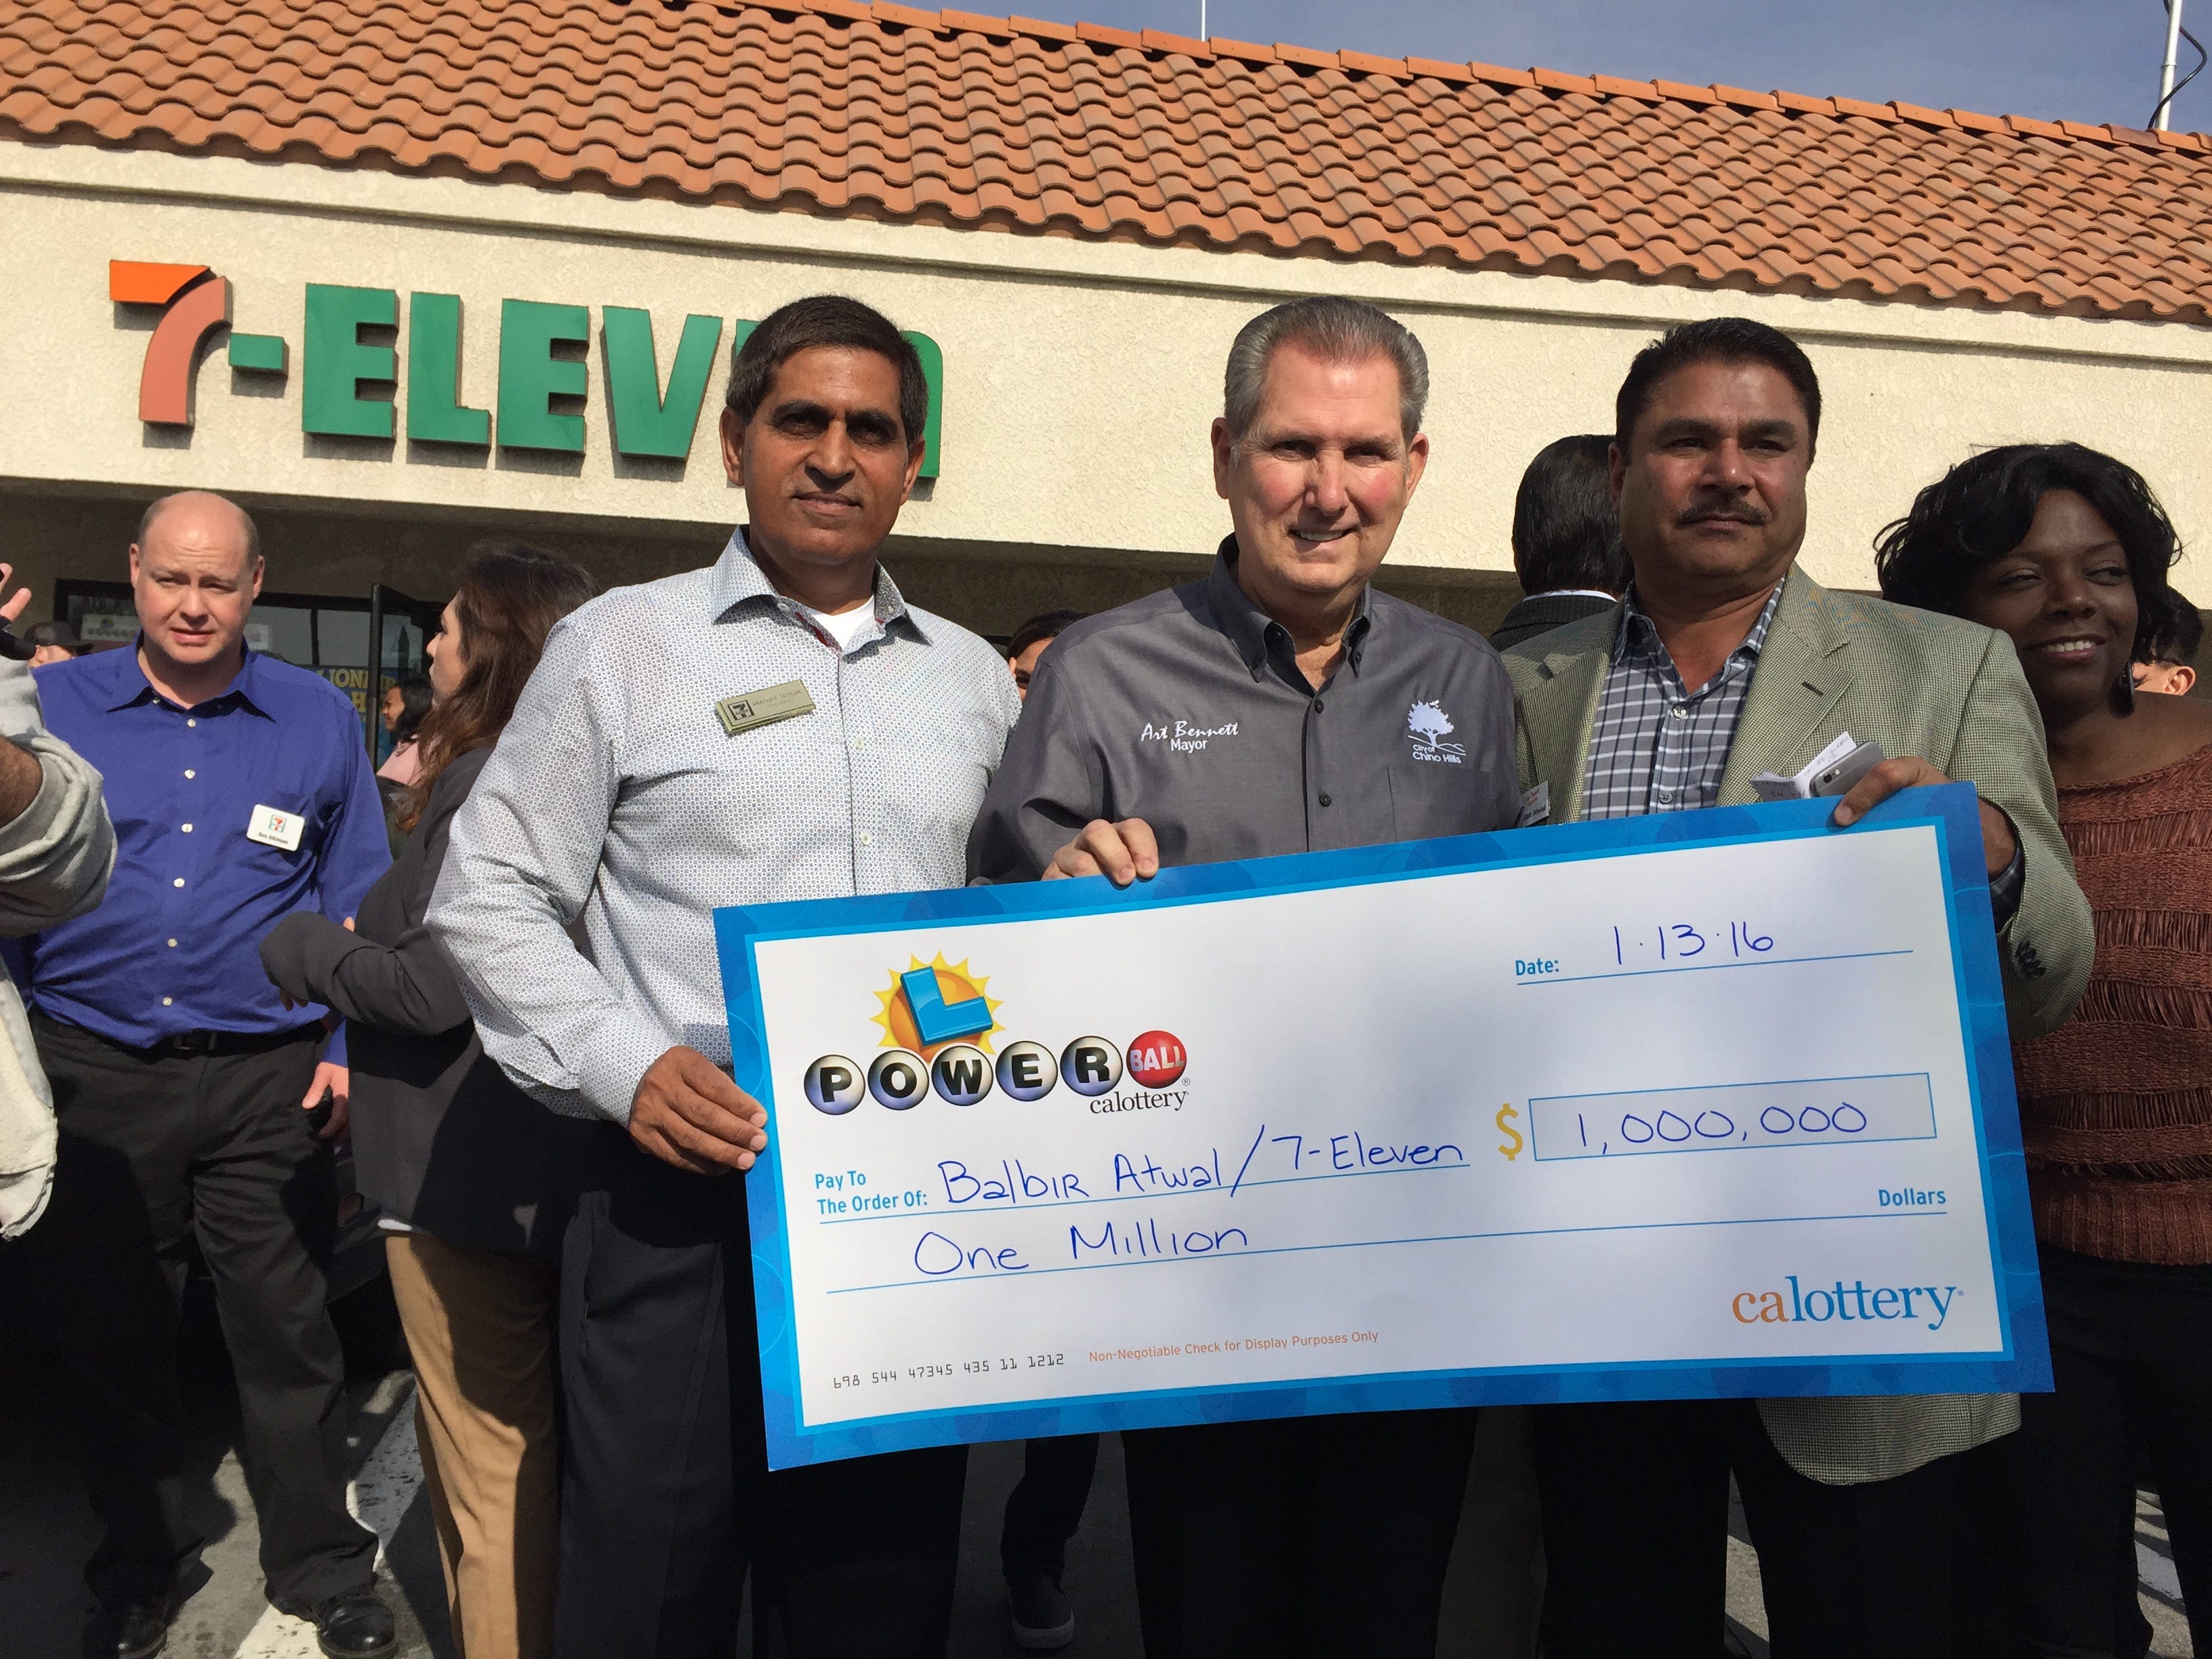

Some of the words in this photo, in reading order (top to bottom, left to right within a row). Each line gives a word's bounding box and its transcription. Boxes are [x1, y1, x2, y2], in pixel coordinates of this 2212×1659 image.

[109, 260, 943, 477] 7-ELEV
[1141, 722, 1168, 741] Art
[1174, 720, 1239, 737] Bennett
[1171, 738, 1208, 754] Mayor
[1412, 744, 1427, 753] City
[1412, 751, 1441, 762] Chino
[1443, 754, 1462, 764] Hills
[1515, 958, 1559, 977] Date:
[1089, 1090, 1187, 1114] calottery
[1578, 1102, 1867, 1155] 1,000,000
[815, 1174, 844, 1191] Pay
[847, 1170, 866, 1186] To
[817, 1198, 846, 1214] The
[852, 1193, 899, 1212] Order
[904, 1190, 928, 1207] Of:
[1879, 1188, 1946, 1206] Dollars
[914, 1231, 1029, 1275] One
[1071, 1218, 1248, 1259] Million
[1732, 1275, 1957, 1330] calottery
[1090, 1345, 1181, 1361] Non-Negotiable
[1185, 1341, 1220, 1355] Check
[1224, 1339, 1240, 1351] for
[1245, 1338, 1288, 1351] Display
[1292, 1334, 1347, 1347] Purposes
[1351, 1330, 1378, 1343] Only
[834, 1374, 860, 1389] 698
[872, 1370, 897, 1384] 544
[909, 1364, 953, 1379] 47345
[964, 1360, 989, 1374] 435
[1000, 1358, 1017, 1370] 11
[1028, 1353, 1064, 1367] 1212
